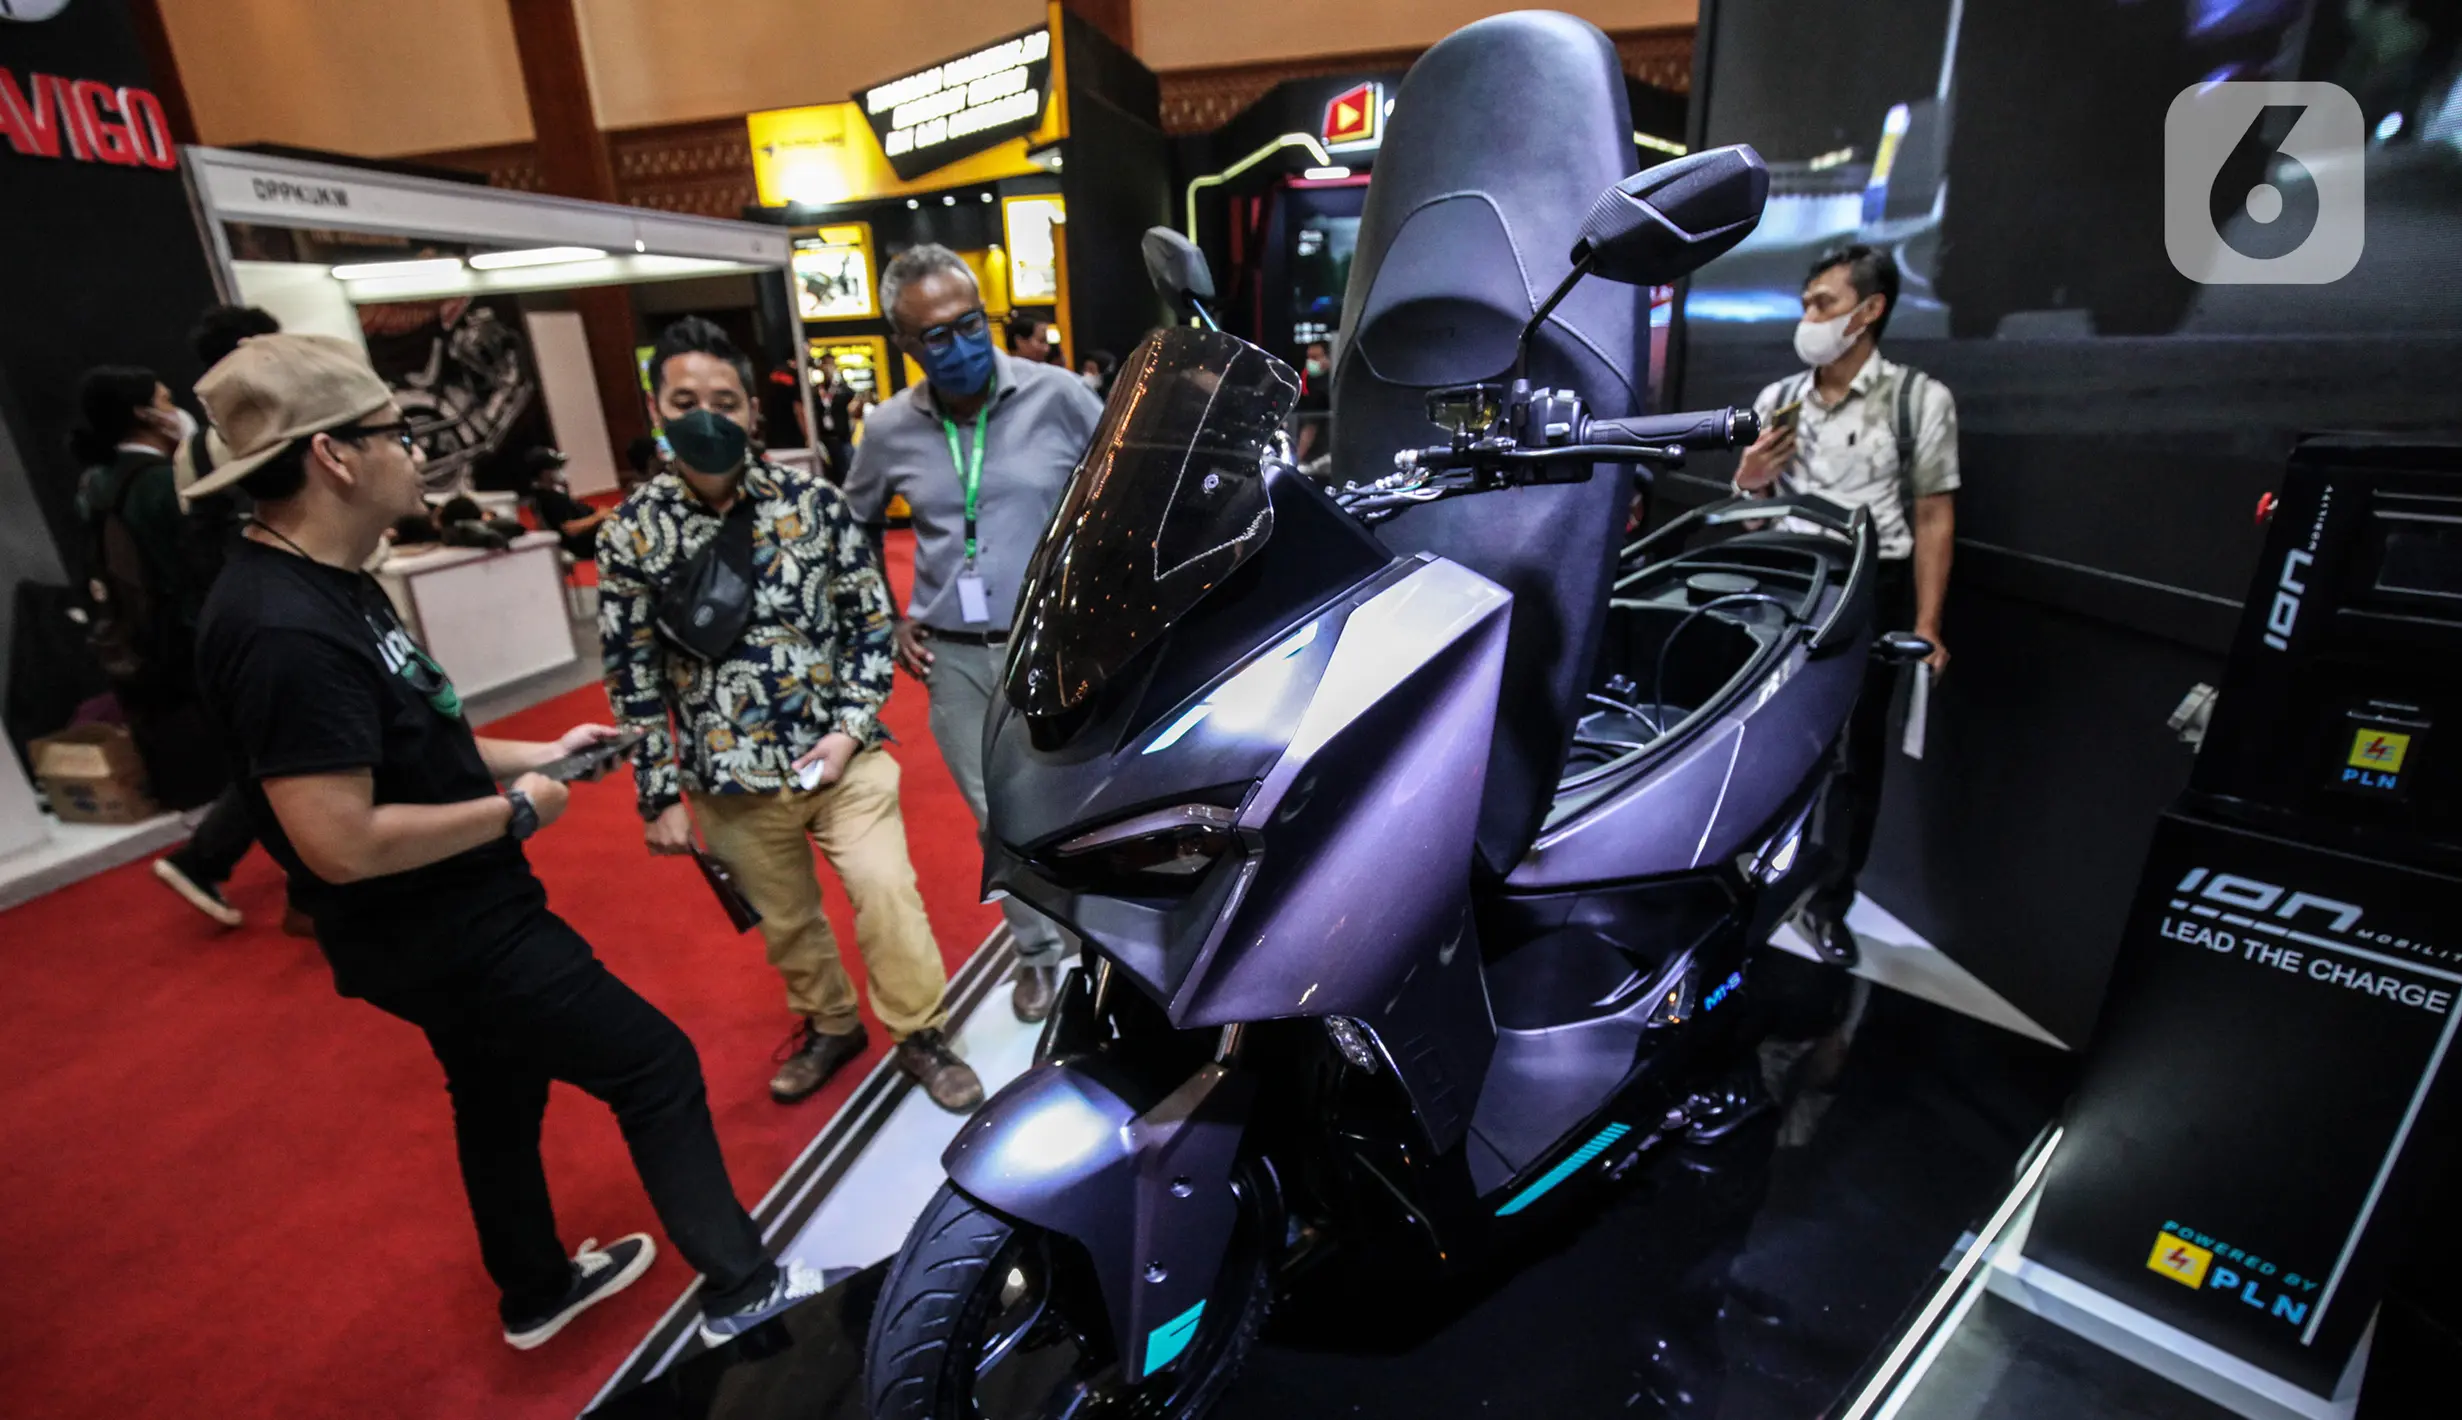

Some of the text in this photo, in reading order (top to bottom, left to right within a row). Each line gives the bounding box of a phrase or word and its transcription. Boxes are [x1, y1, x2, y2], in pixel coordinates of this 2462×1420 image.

[2342, 768, 2397, 789] PLN
[2160, 917, 2452, 1013] LEAD THE CHARGE
[2162, 1219, 2318, 1292] POWERED BY
[2209, 1266, 2308, 1325] PLN
